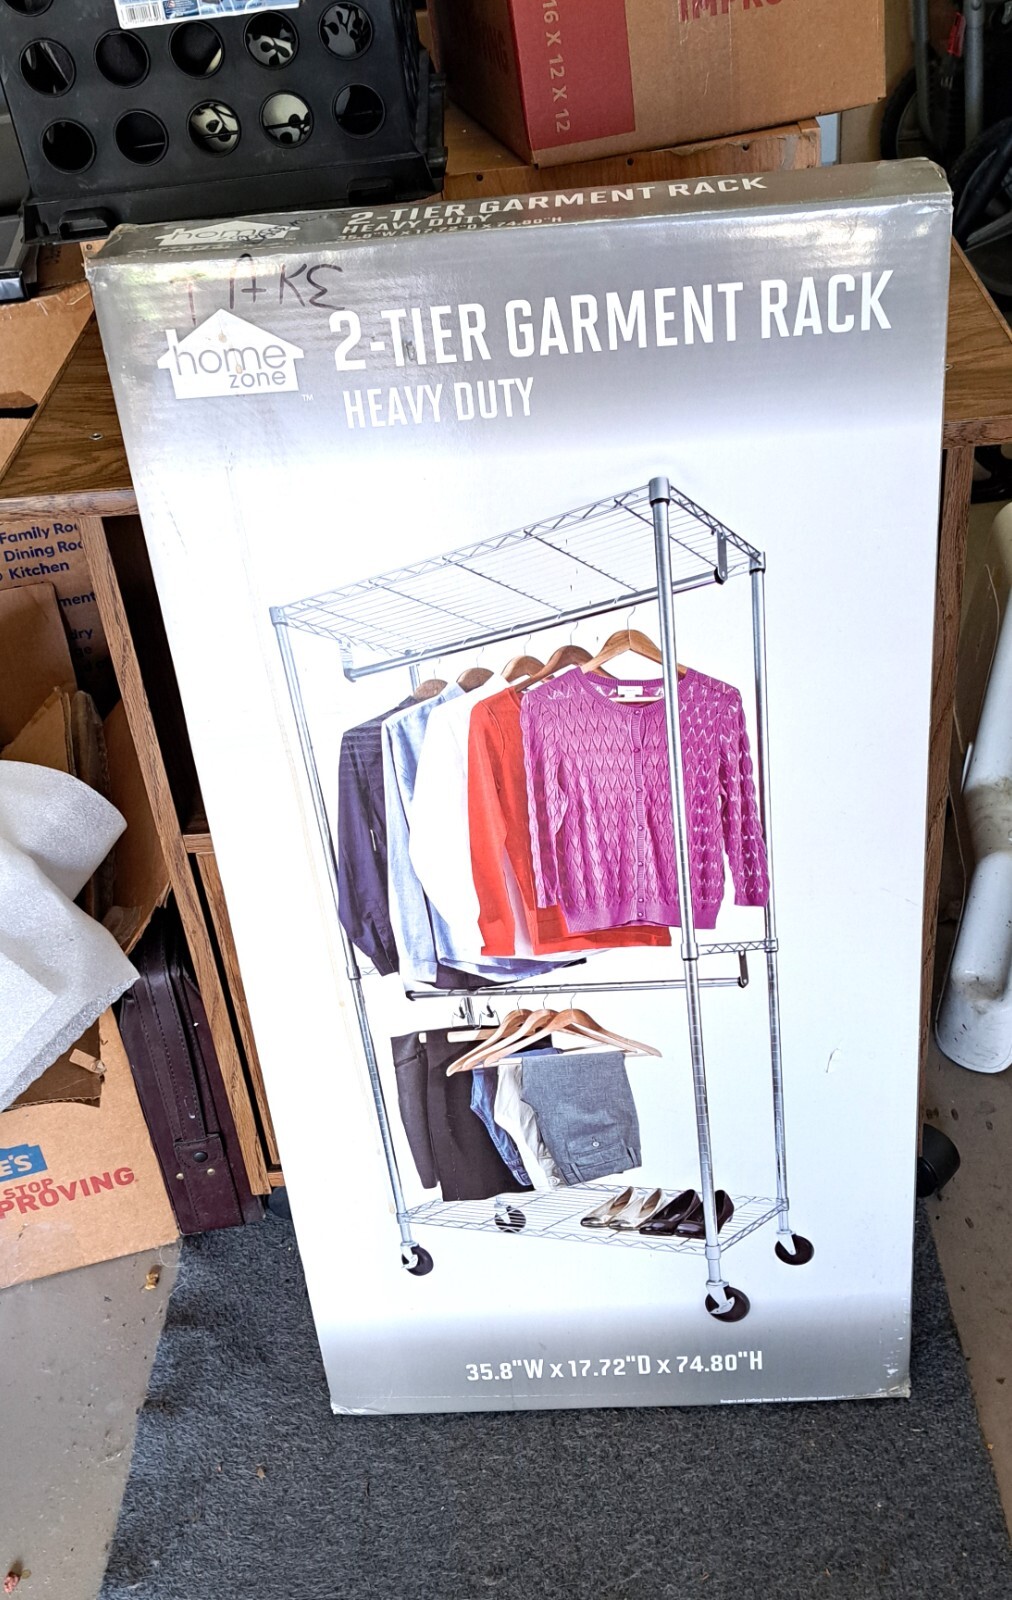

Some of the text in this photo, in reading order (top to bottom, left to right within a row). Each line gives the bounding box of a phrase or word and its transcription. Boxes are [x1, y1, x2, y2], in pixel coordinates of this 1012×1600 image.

[680, 0, 782, 22] IMP
[549, 54, 565, 80] 12
[555, 109, 571, 133] 12
[347, 176, 768, 225] 2-TIER GARMENT RACK
[342, 214, 493, 234] HEAVY DUTY
[328, 270, 895, 372] 2-TIER GARMENT RACK
[172, 344, 287, 376] home
[228, 370, 287, 389] zone
[342, 377, 534, 430] HEAVY DUTY
[0, 526, 50, 544] Family
[4, 546, 55, 562] Dining
[9, 561, 70, 579] Kitchen
[0, 1166, 135, 1220] PROVING
[3, 1178, 54, 1200] STOP
[465, 1358, 544, 1381] 35.8"W
[568, 1354, 651, 1378] 17.72"D
[676, 1350, 763, 1374] 74.80"H
